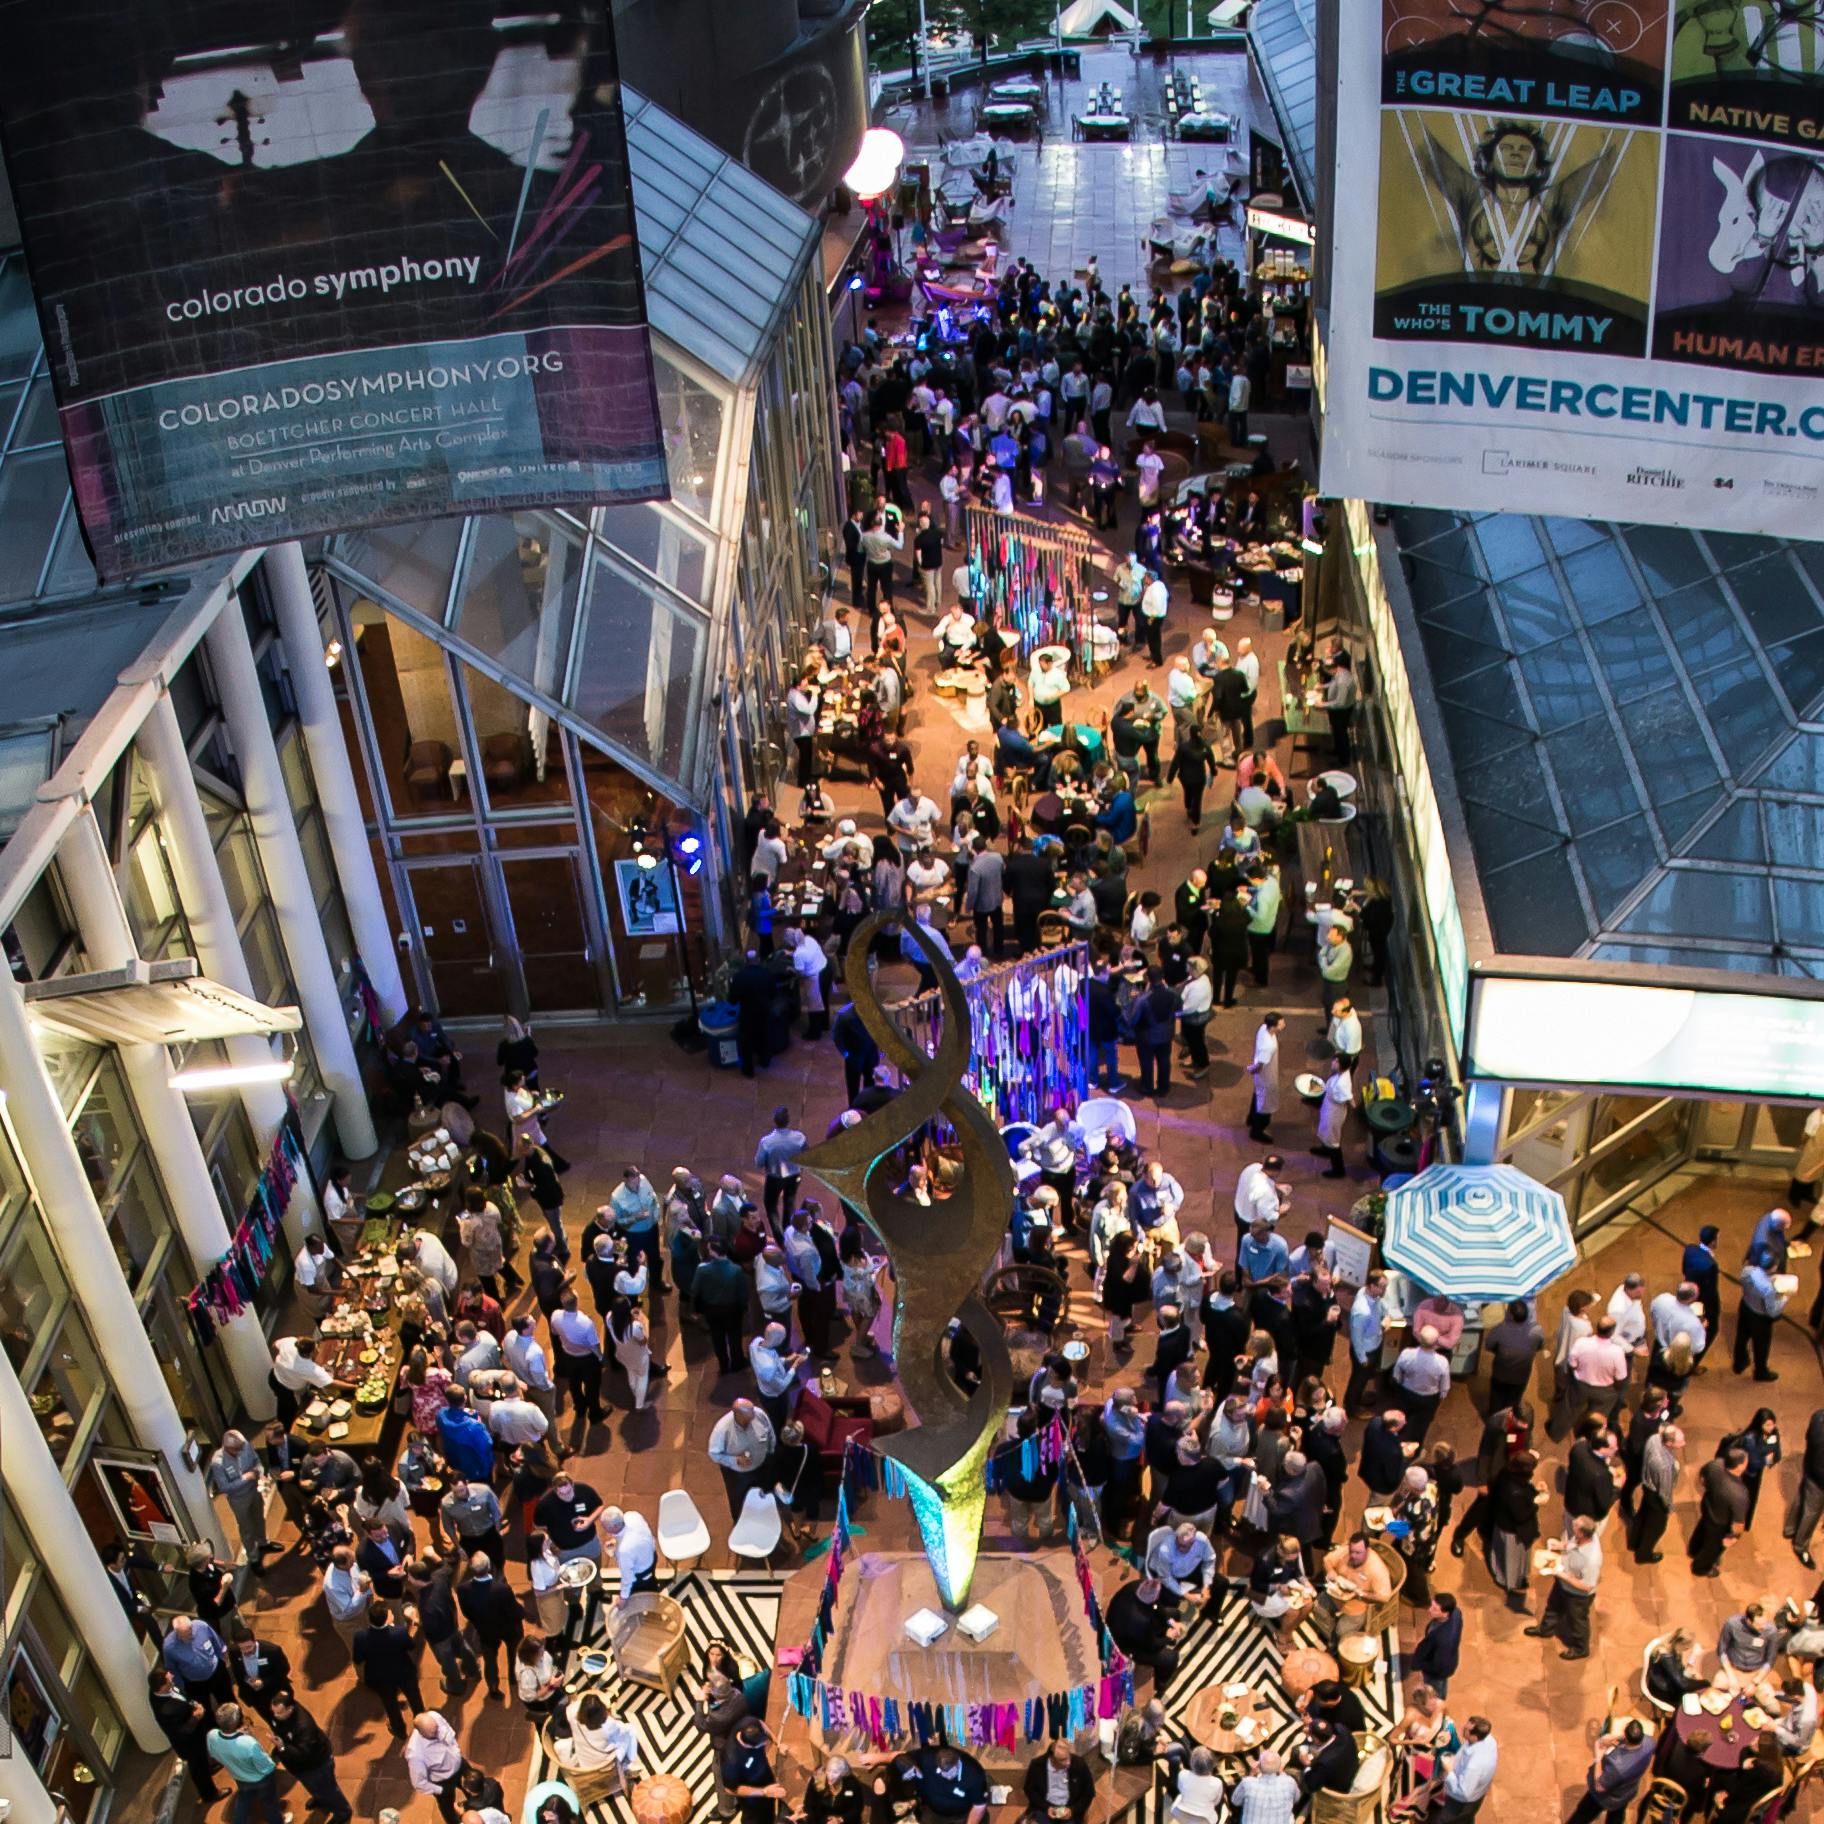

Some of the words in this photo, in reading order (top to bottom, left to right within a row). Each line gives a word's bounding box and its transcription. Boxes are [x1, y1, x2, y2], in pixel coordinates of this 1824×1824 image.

[1410, 70, 1536, 107] GREAT
[1546, 80, 1642, 114] LEAP
[1689, 100, 1790, 136] NATIVE
[165, 274, 308, 323] colorado
[313, 254, 482, 300] symphony
[1393, 315, 1452, 332] WHO'S
[1418, 301, 1452, 319] THE
[1459, 305, 1614, 345] TOMMY
[1672, 330, 1789, 368] HUMAN
[158, 351, 564, 431] COLORADOSYMPHONY.ORG
[226, 418, 344, 451] BOETTCHER
[350, 404, 443, 430] CONCERT
[451, 396, 501, 417] HALL
[248, 455, 305, 476] Denver
[309, 440, 395, 465] Performing
[398, 435, 431, 453] Arts
[435, 424, 509, 449] Complex
[1500, 458, 1549, 470] LARIMER
[1554, 462, 1597, 476] SQUARE
[211, 496, 287, 526] ARROW
